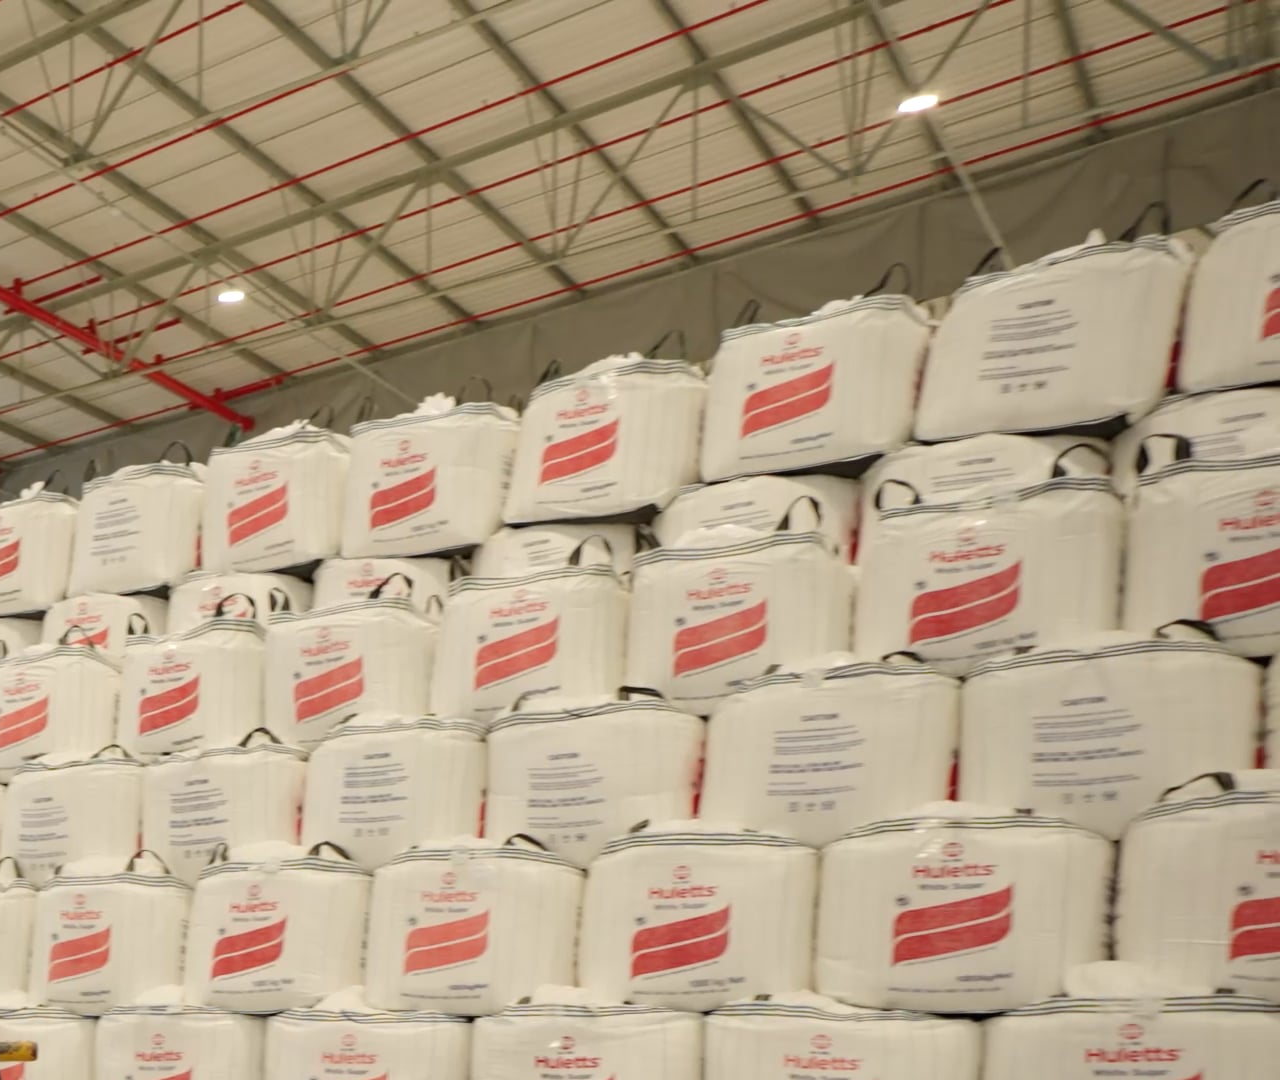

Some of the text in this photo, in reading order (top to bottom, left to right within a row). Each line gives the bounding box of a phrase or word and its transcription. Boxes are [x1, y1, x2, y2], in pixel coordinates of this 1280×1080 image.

[928, 543, 1005, 563] Huletts
[912, 864, 995, 879] Huletts
[783, 1055, 861, 1071] Huletts
[1085, 1048, 1180, 1063] Huletts
